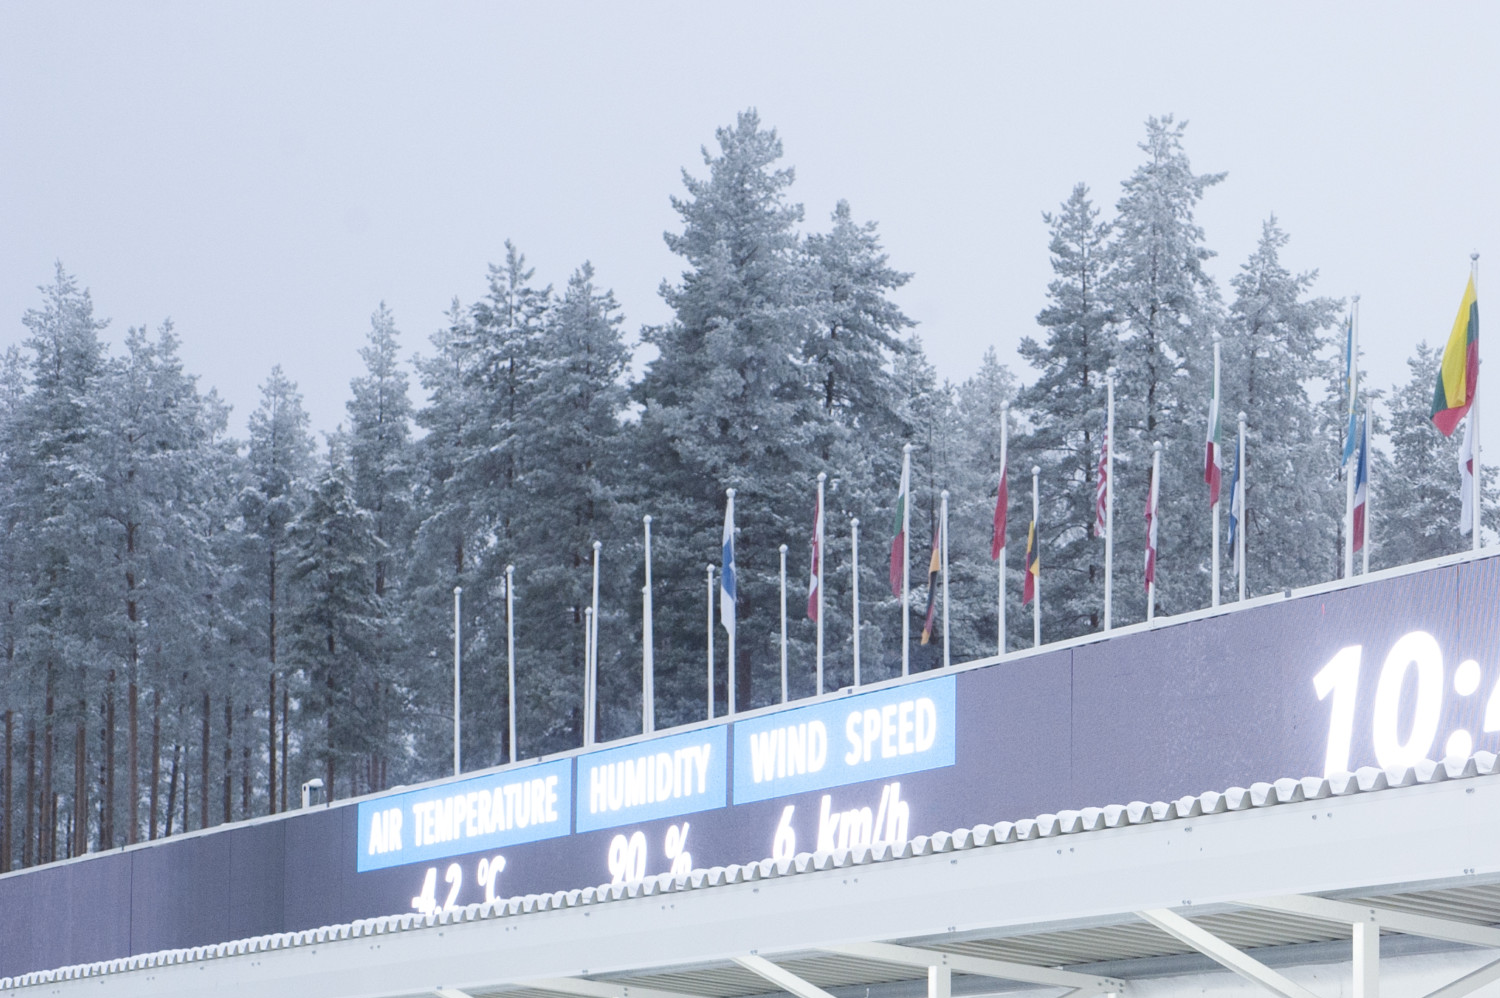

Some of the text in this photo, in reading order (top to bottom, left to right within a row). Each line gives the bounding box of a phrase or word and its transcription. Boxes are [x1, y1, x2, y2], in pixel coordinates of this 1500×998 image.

[589, 742, 712, 815] HUMIDITY
[750, 696, 937, 785] WIND SPEED
[368, 775, 559, 856] AIR TEMPERATURE
[607, 821, 692, 885] 90 %
[772, 781, 911, 861] 6 km/h
